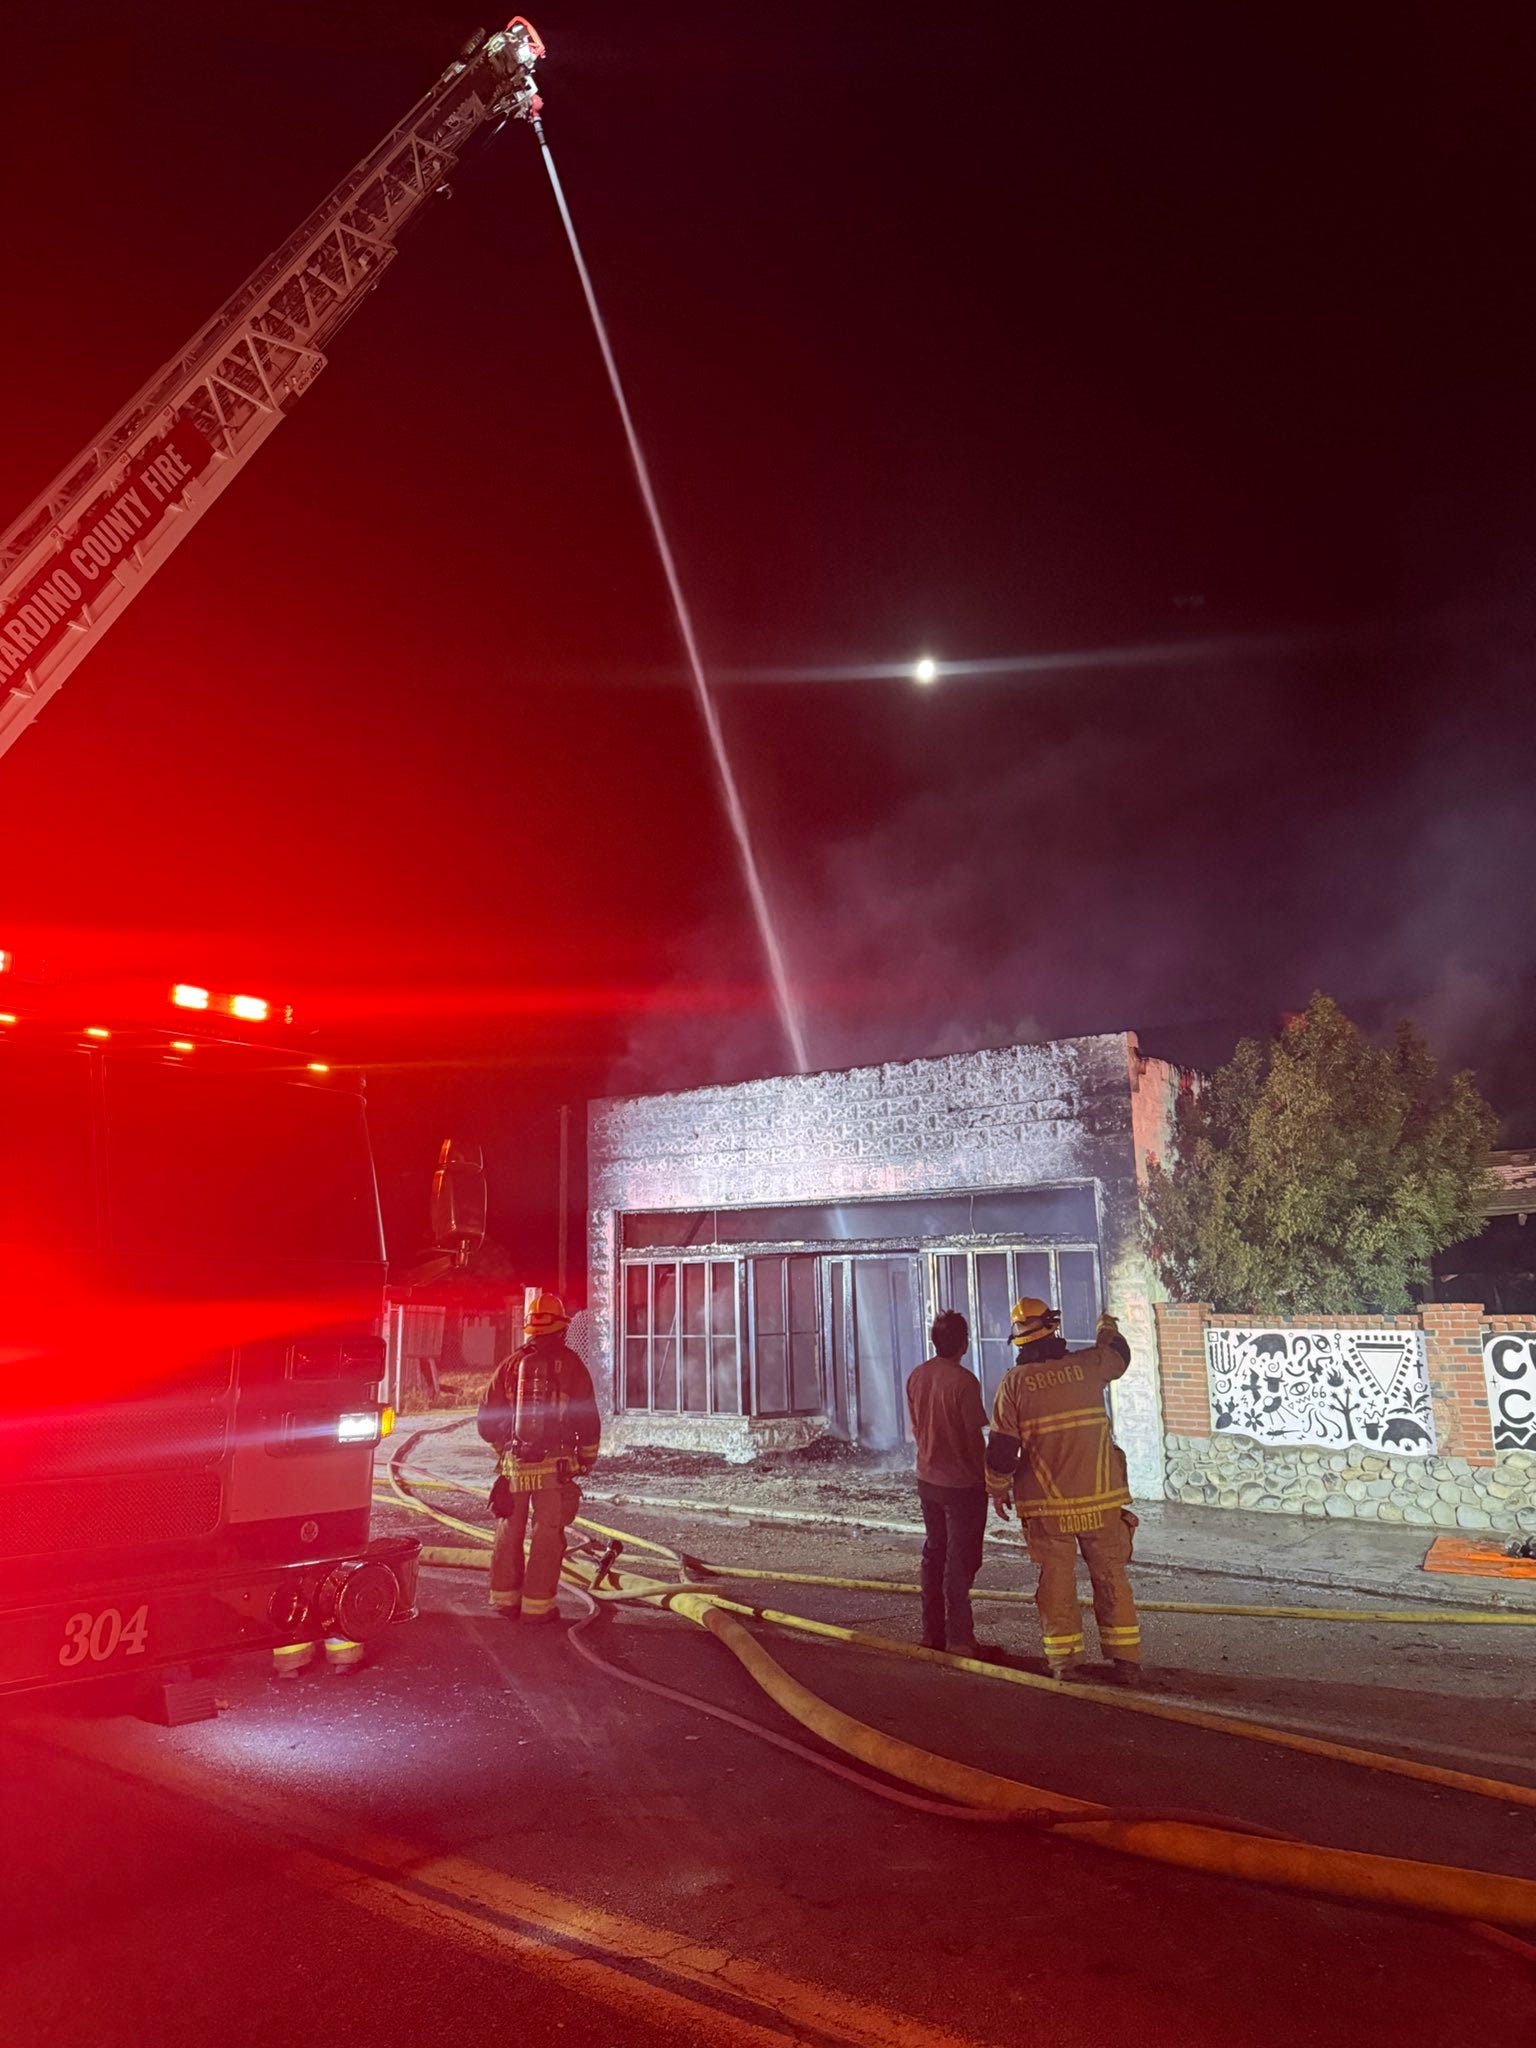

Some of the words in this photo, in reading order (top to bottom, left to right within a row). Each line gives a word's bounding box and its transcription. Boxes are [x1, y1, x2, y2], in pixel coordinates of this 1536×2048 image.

[70, 486, 151, 580] COUNTY
[140, 443, 192, 502] FIRE
[1491, 1339, 1536, 1380] C
[520, 1474, 543, 1491] FRYE
[1059, 1512, 1104, 1533] CADDELL
[59, 1605, 148, 1667] 304
